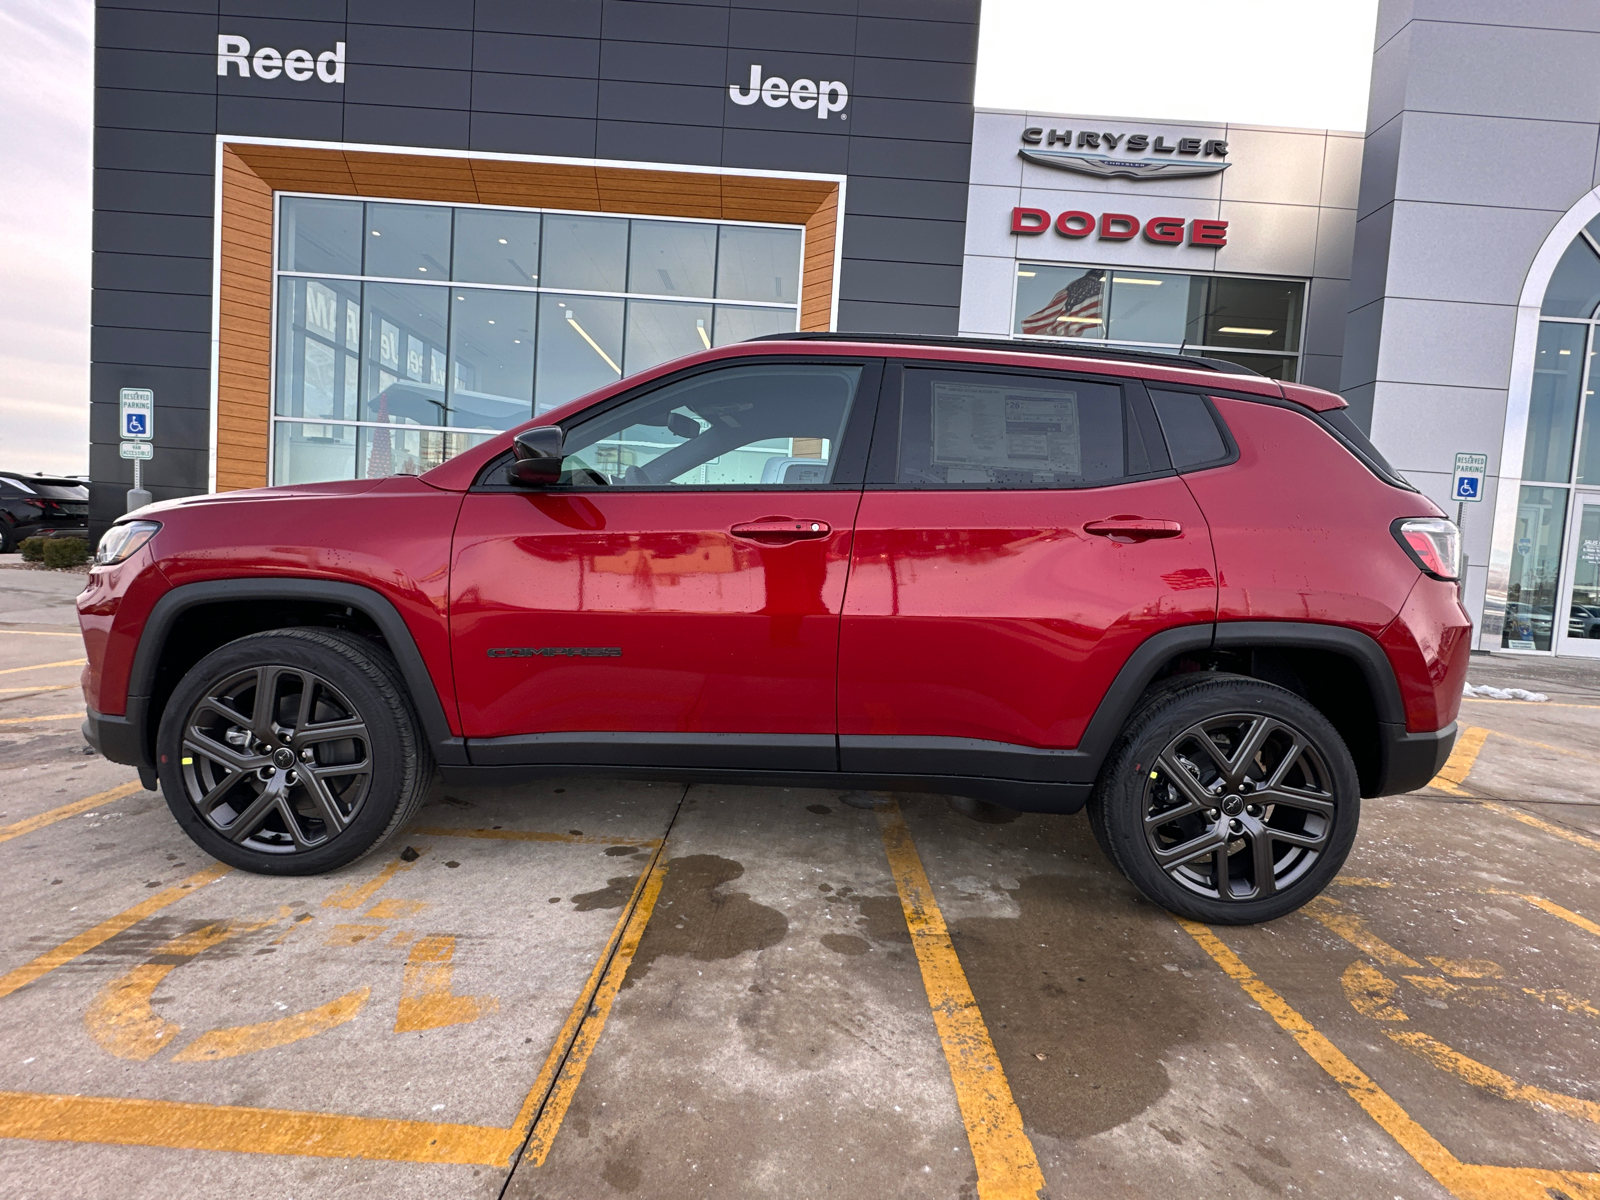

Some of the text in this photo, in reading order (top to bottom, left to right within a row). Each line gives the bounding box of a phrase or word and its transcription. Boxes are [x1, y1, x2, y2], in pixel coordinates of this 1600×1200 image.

[217, 34, 347, 84] Reed
[729, 64, 848, 120] Jeep
[1022, 127, 1229, 156] CHRYSLER
[1011, 206, 1229, 248] DODGE
[123, 393, 149, 401] RESERVED
[123, 401, 150, 409] PARKING
[1457, 456, 1484, 465] RESERVED
[1456, 465, 1484, 473] PARKING
[486, 647, 623, 658] COMPASS
